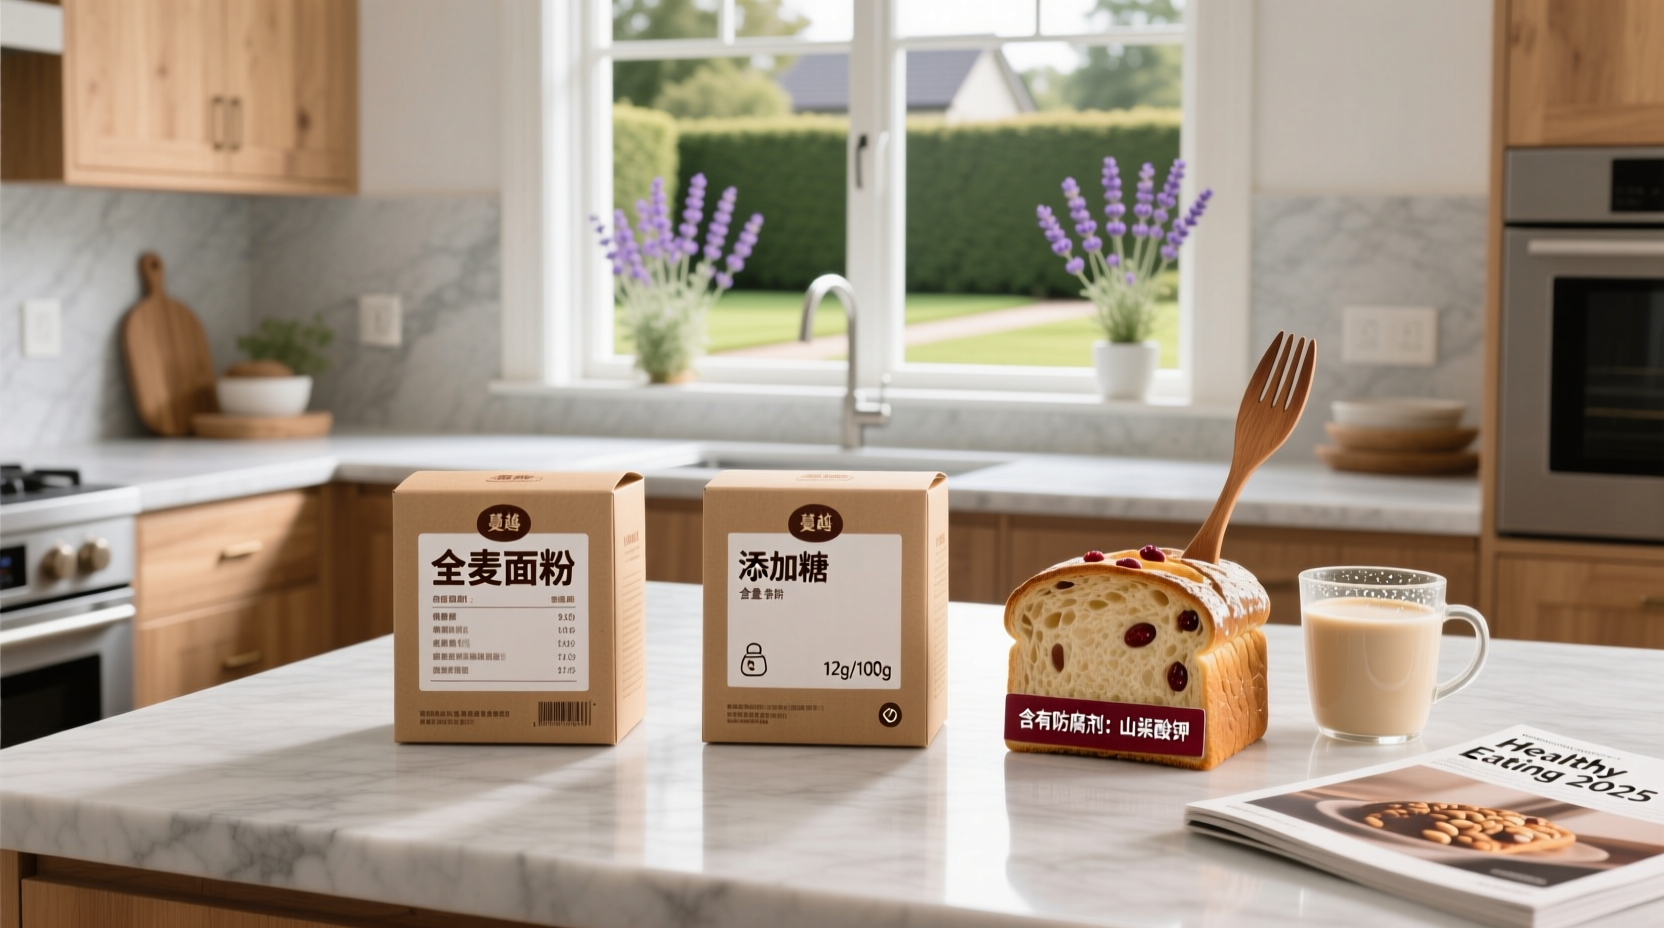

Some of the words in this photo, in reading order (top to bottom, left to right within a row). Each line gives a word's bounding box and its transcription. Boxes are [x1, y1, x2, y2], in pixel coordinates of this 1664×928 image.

[431, 548, 575, 587] 全麦面粉
[738, 550, 829, 584] 添加糖
[823, 660, 892, 681] 12g/100g
[1458, 746, 1566, 783] Eating
[1565, 774, 1659, 802] 2025
[1495, 738, 1628, 778] Healthy
